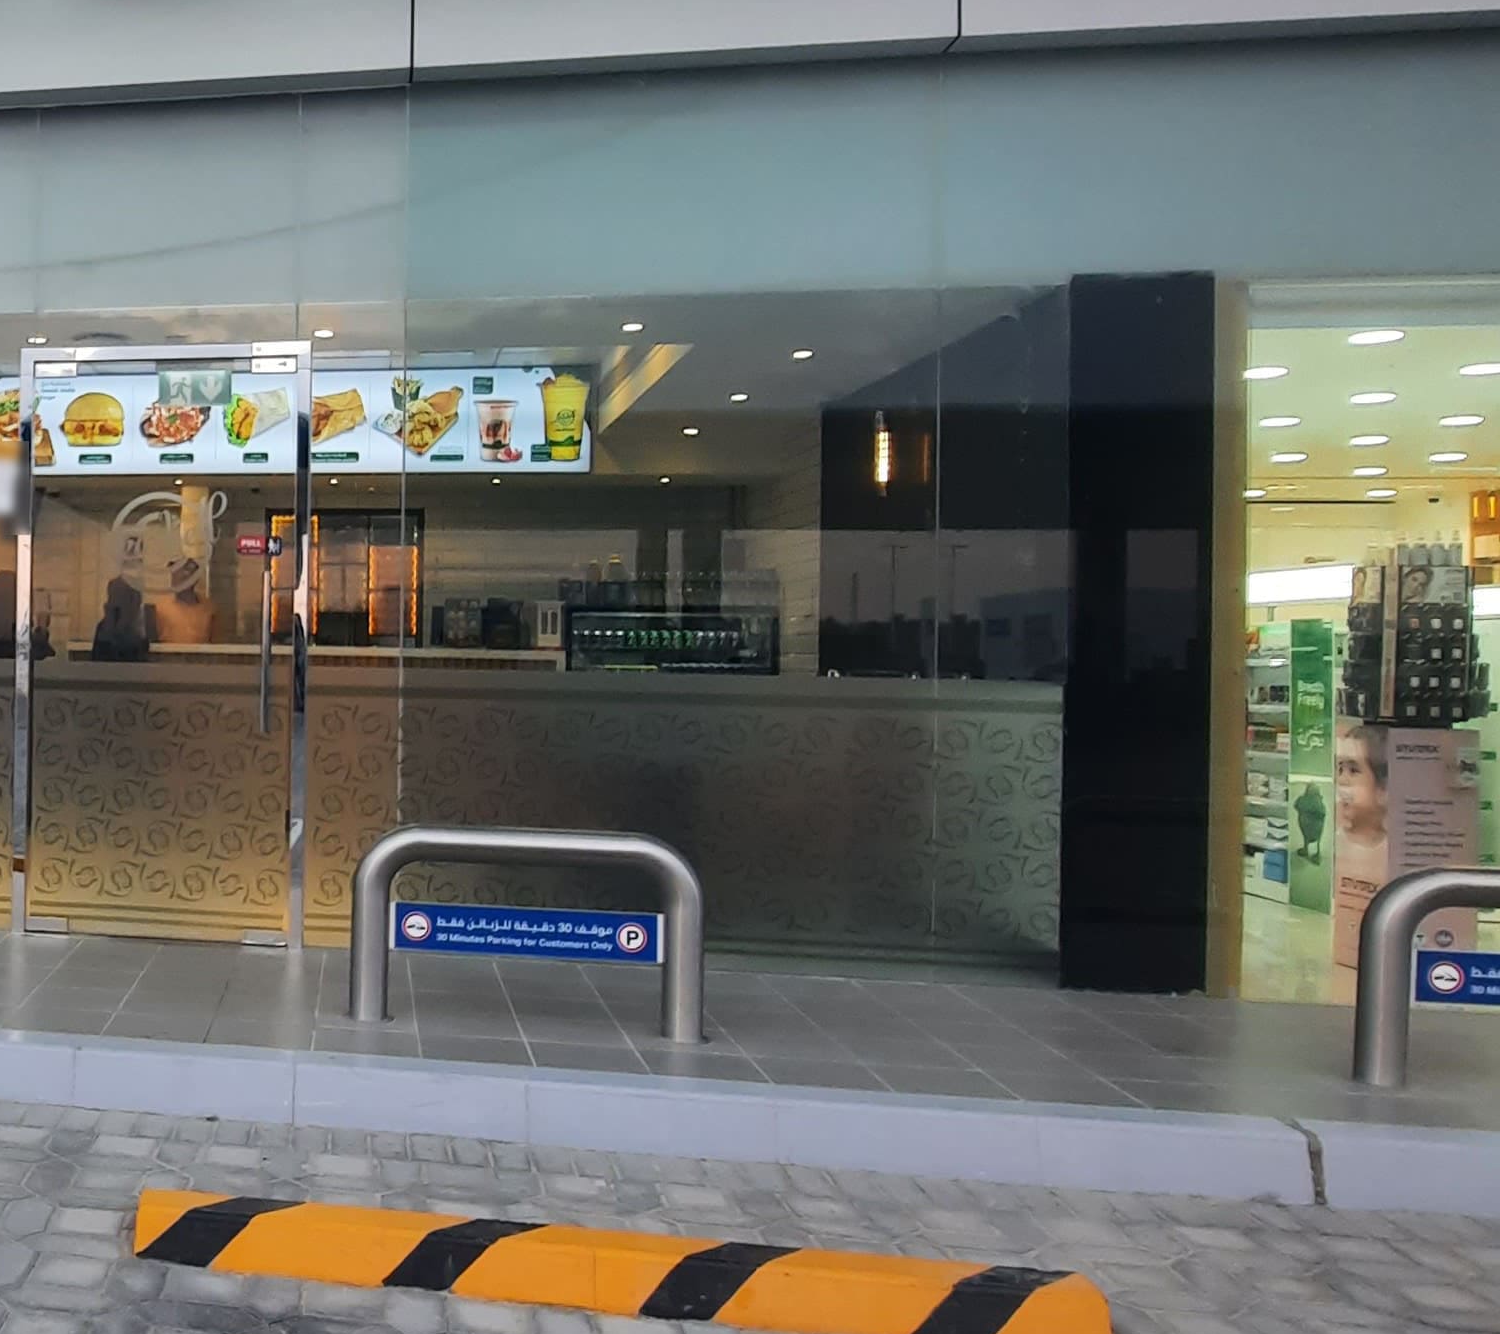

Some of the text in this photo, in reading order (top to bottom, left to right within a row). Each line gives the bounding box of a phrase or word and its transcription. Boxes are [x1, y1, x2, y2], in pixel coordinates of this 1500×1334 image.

[436, 916, 465, 927] فقط
[513, 919, 556, 934] دقيقة
[557, 921, 573, 933] 30
[573, 923, 614, 938] موقف
[436, 933, 614, 952] 30 Minutes Parking for Customers Only
